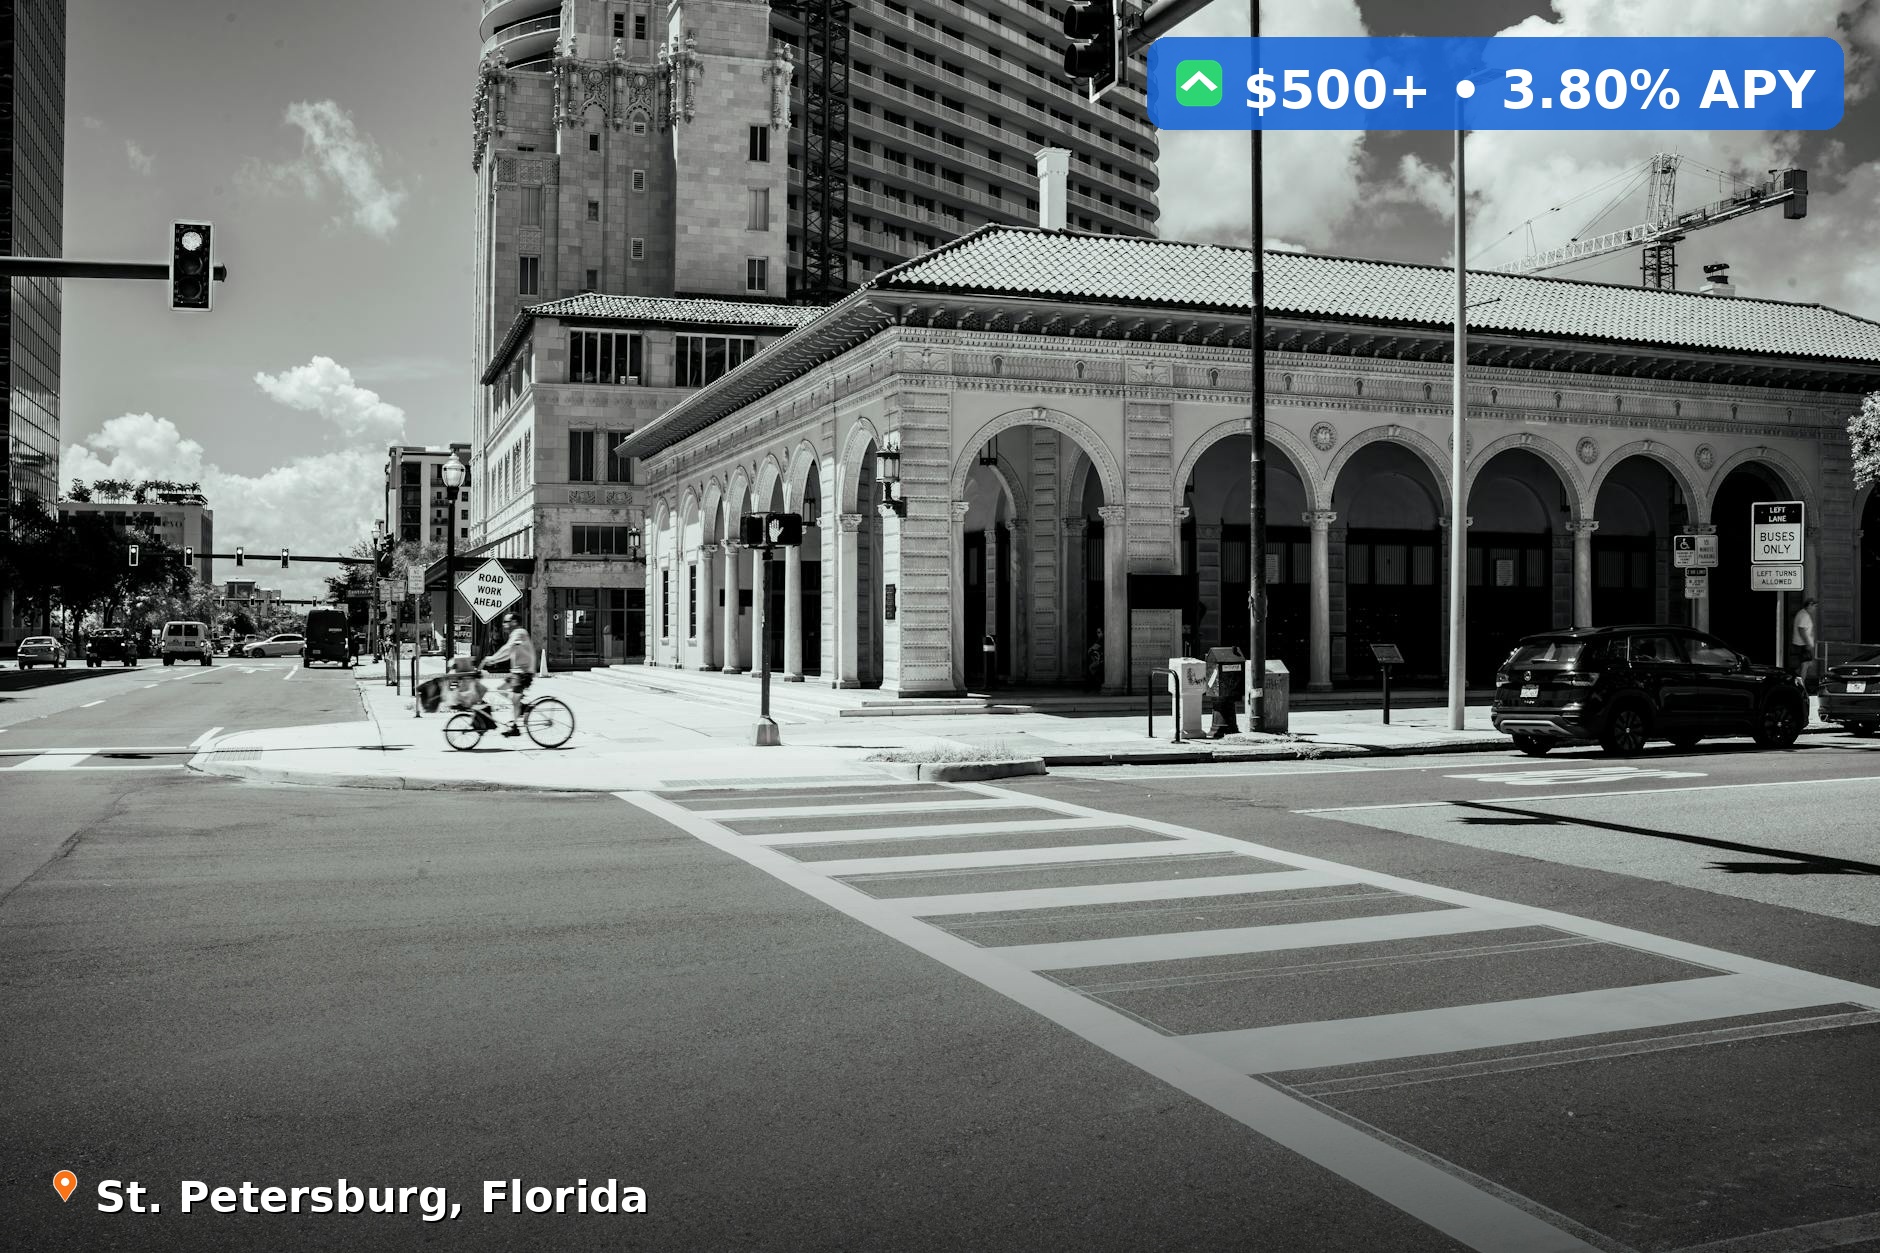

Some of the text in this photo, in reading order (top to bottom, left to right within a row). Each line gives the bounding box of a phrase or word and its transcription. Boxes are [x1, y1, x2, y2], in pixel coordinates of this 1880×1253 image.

[1769, 506, 1786, 514] LEFT
[1768, 515, 1787, 523] LANE
[1760, 532, 1795, 542] BUSES
[1763, 544, 1791, 554] ONLY
[478, 573, 504, 584] ROAD
[477, 585, 502, 596] WORK
[473, 597, 503, 608] AHEAD
